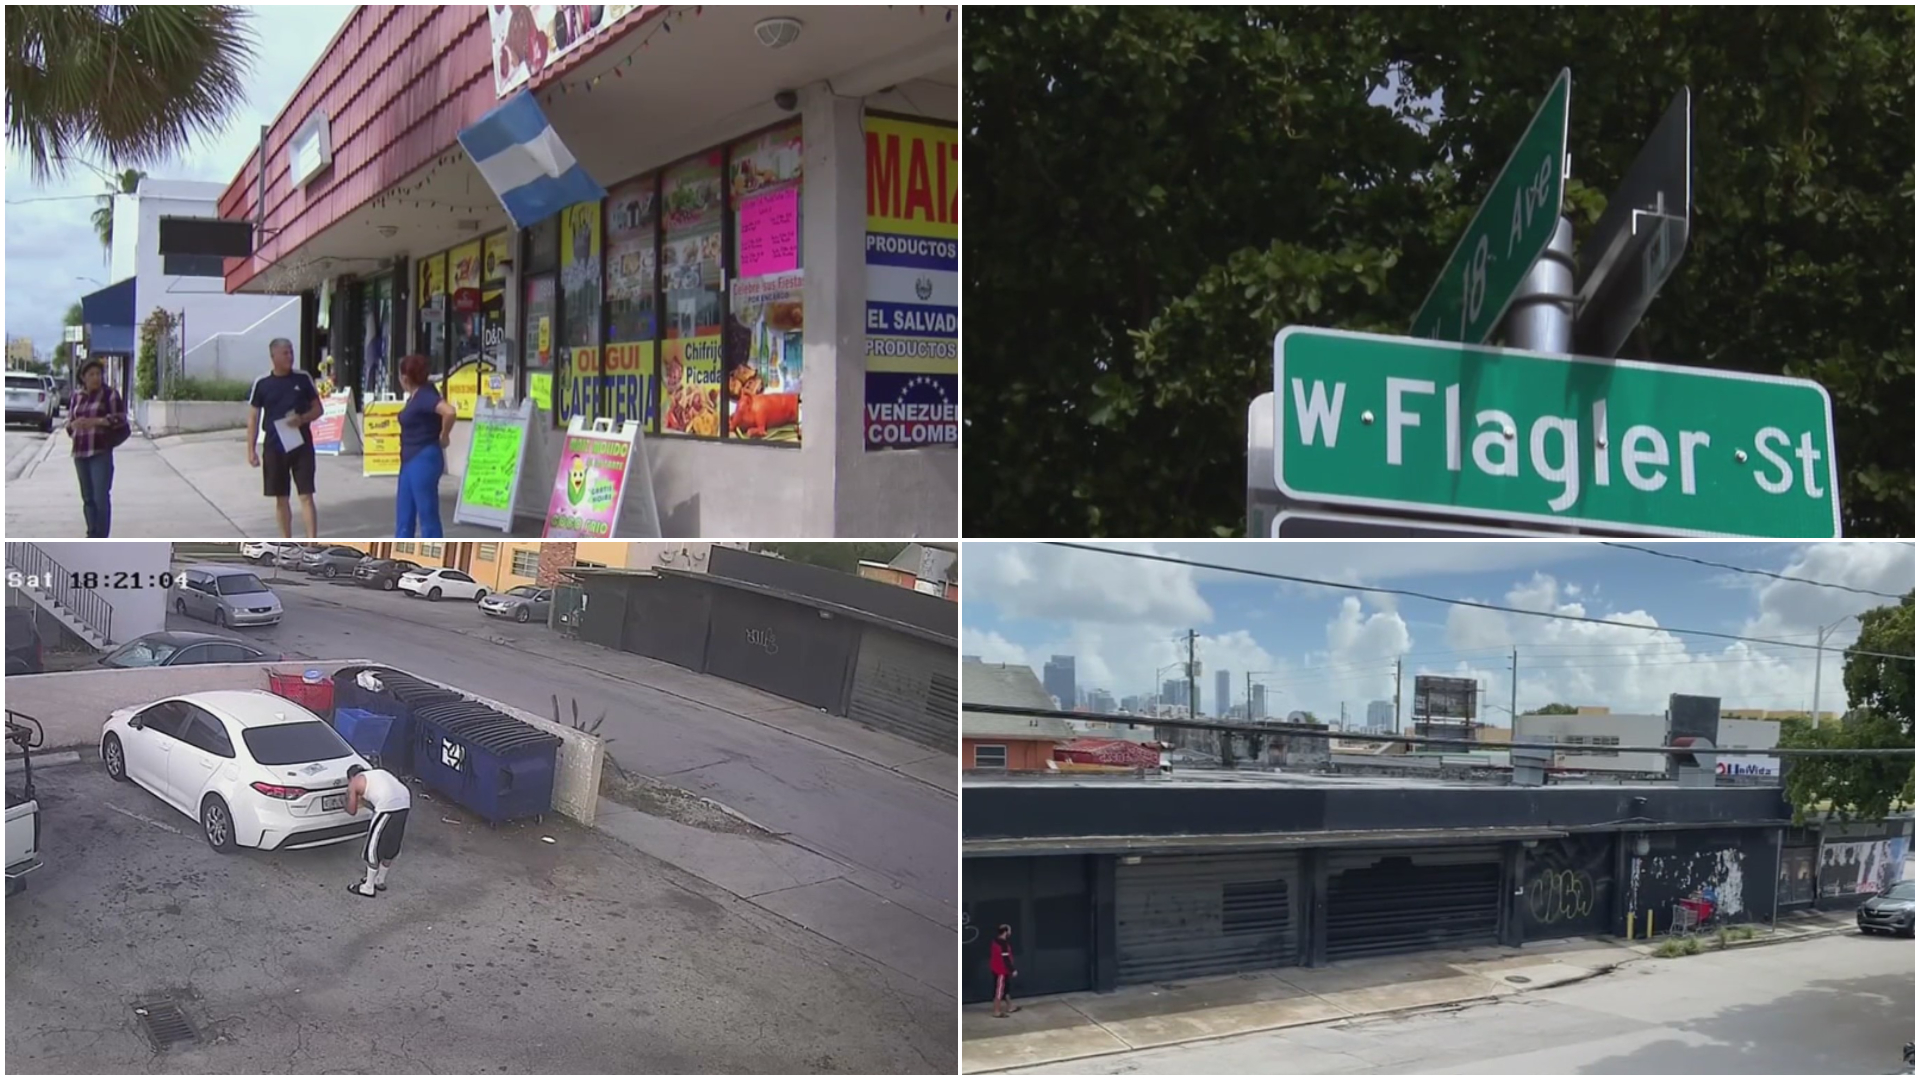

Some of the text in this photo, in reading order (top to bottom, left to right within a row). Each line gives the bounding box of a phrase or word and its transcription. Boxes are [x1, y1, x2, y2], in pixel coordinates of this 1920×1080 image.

[1508, 154, 1551, 259] Ave
[866, 235, 956, 259] PRODUCTOS
[778, 275, 805, 290] Fiesta
[867, 309, 958, 332] EL SALVAD
[866, 338, 956, 359] PRODUCTOS
[559, 373, 656, 427] CAFETERIA
[868, 424, 958, 443] COLOMB
[1291, 375, 1825, 513] W Flagler St
